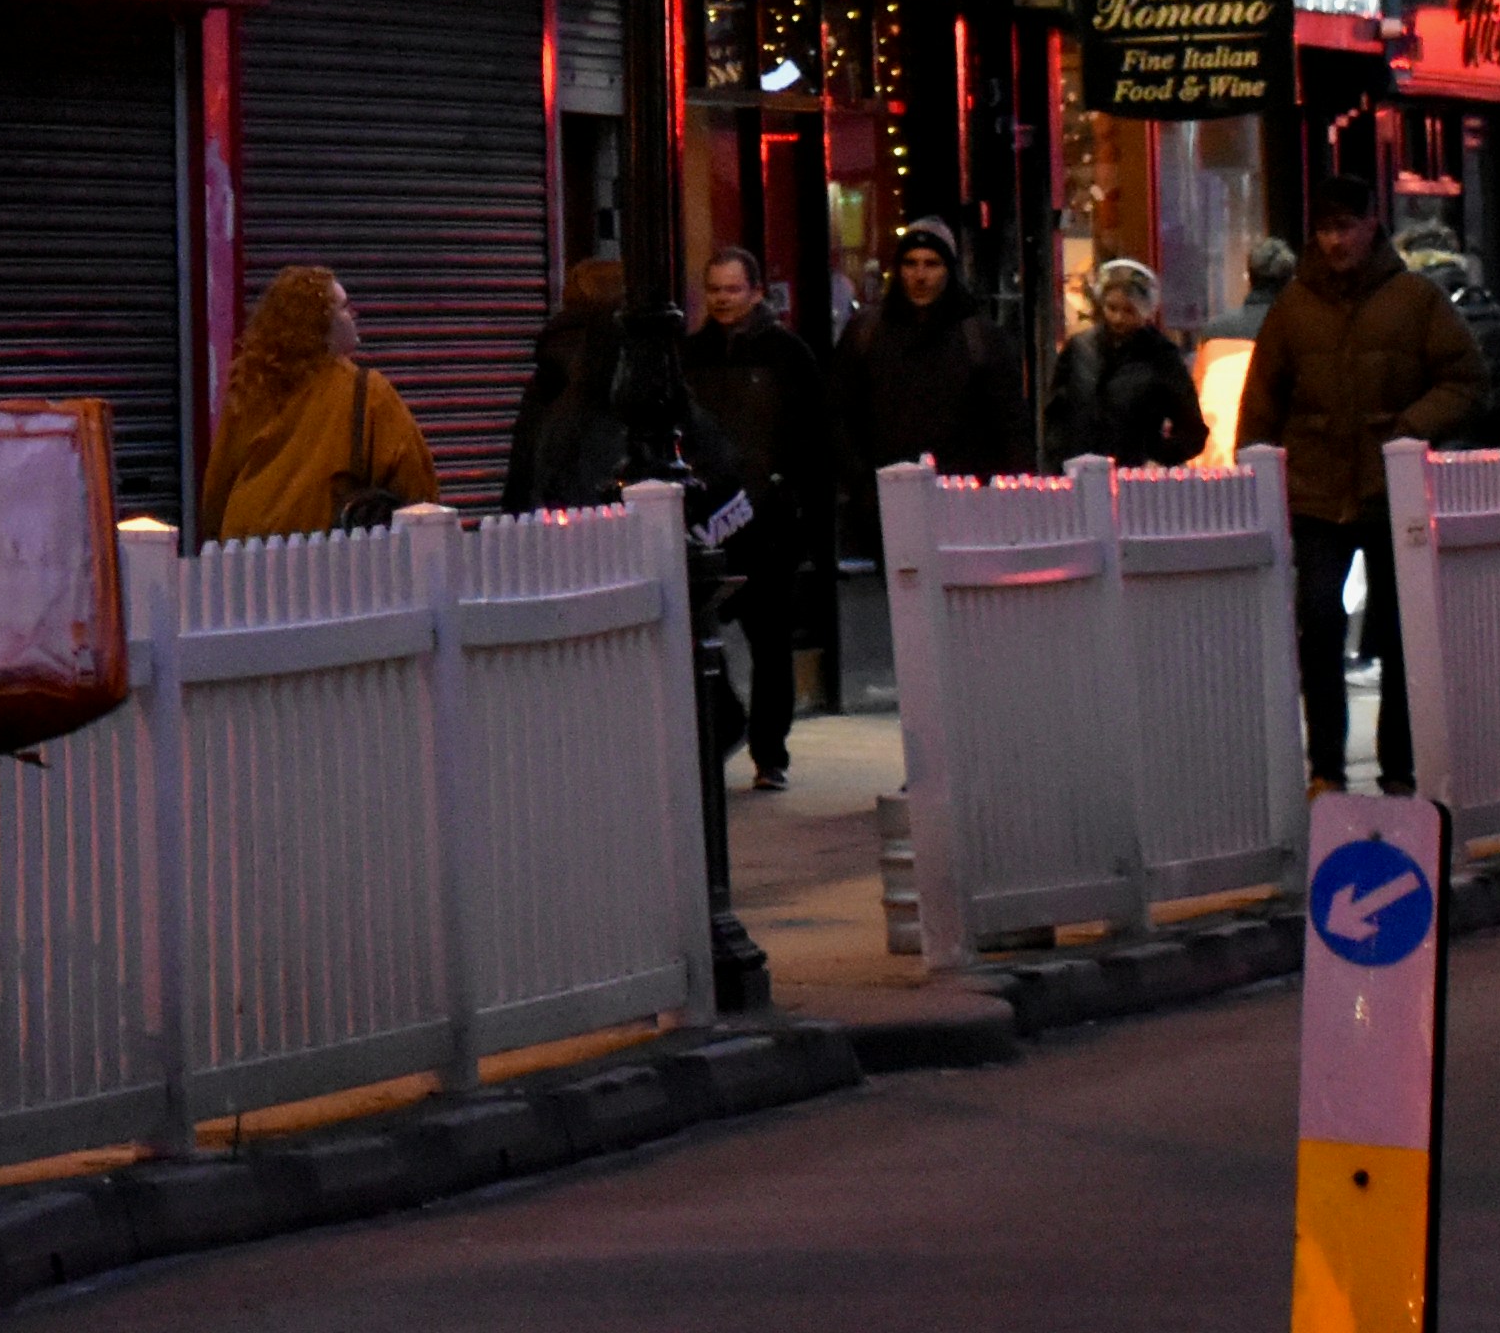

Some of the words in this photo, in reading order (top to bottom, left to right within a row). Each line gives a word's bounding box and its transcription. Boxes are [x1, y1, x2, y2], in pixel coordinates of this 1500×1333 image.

[1121, 46, 1176, 73] Fine
[1182, 44, 1260, 70] Italian
[1112, 77, 1175, 104] Food
[1178, 74, 1206, 103] &
[1208, 74, 1267, 99] Wine
